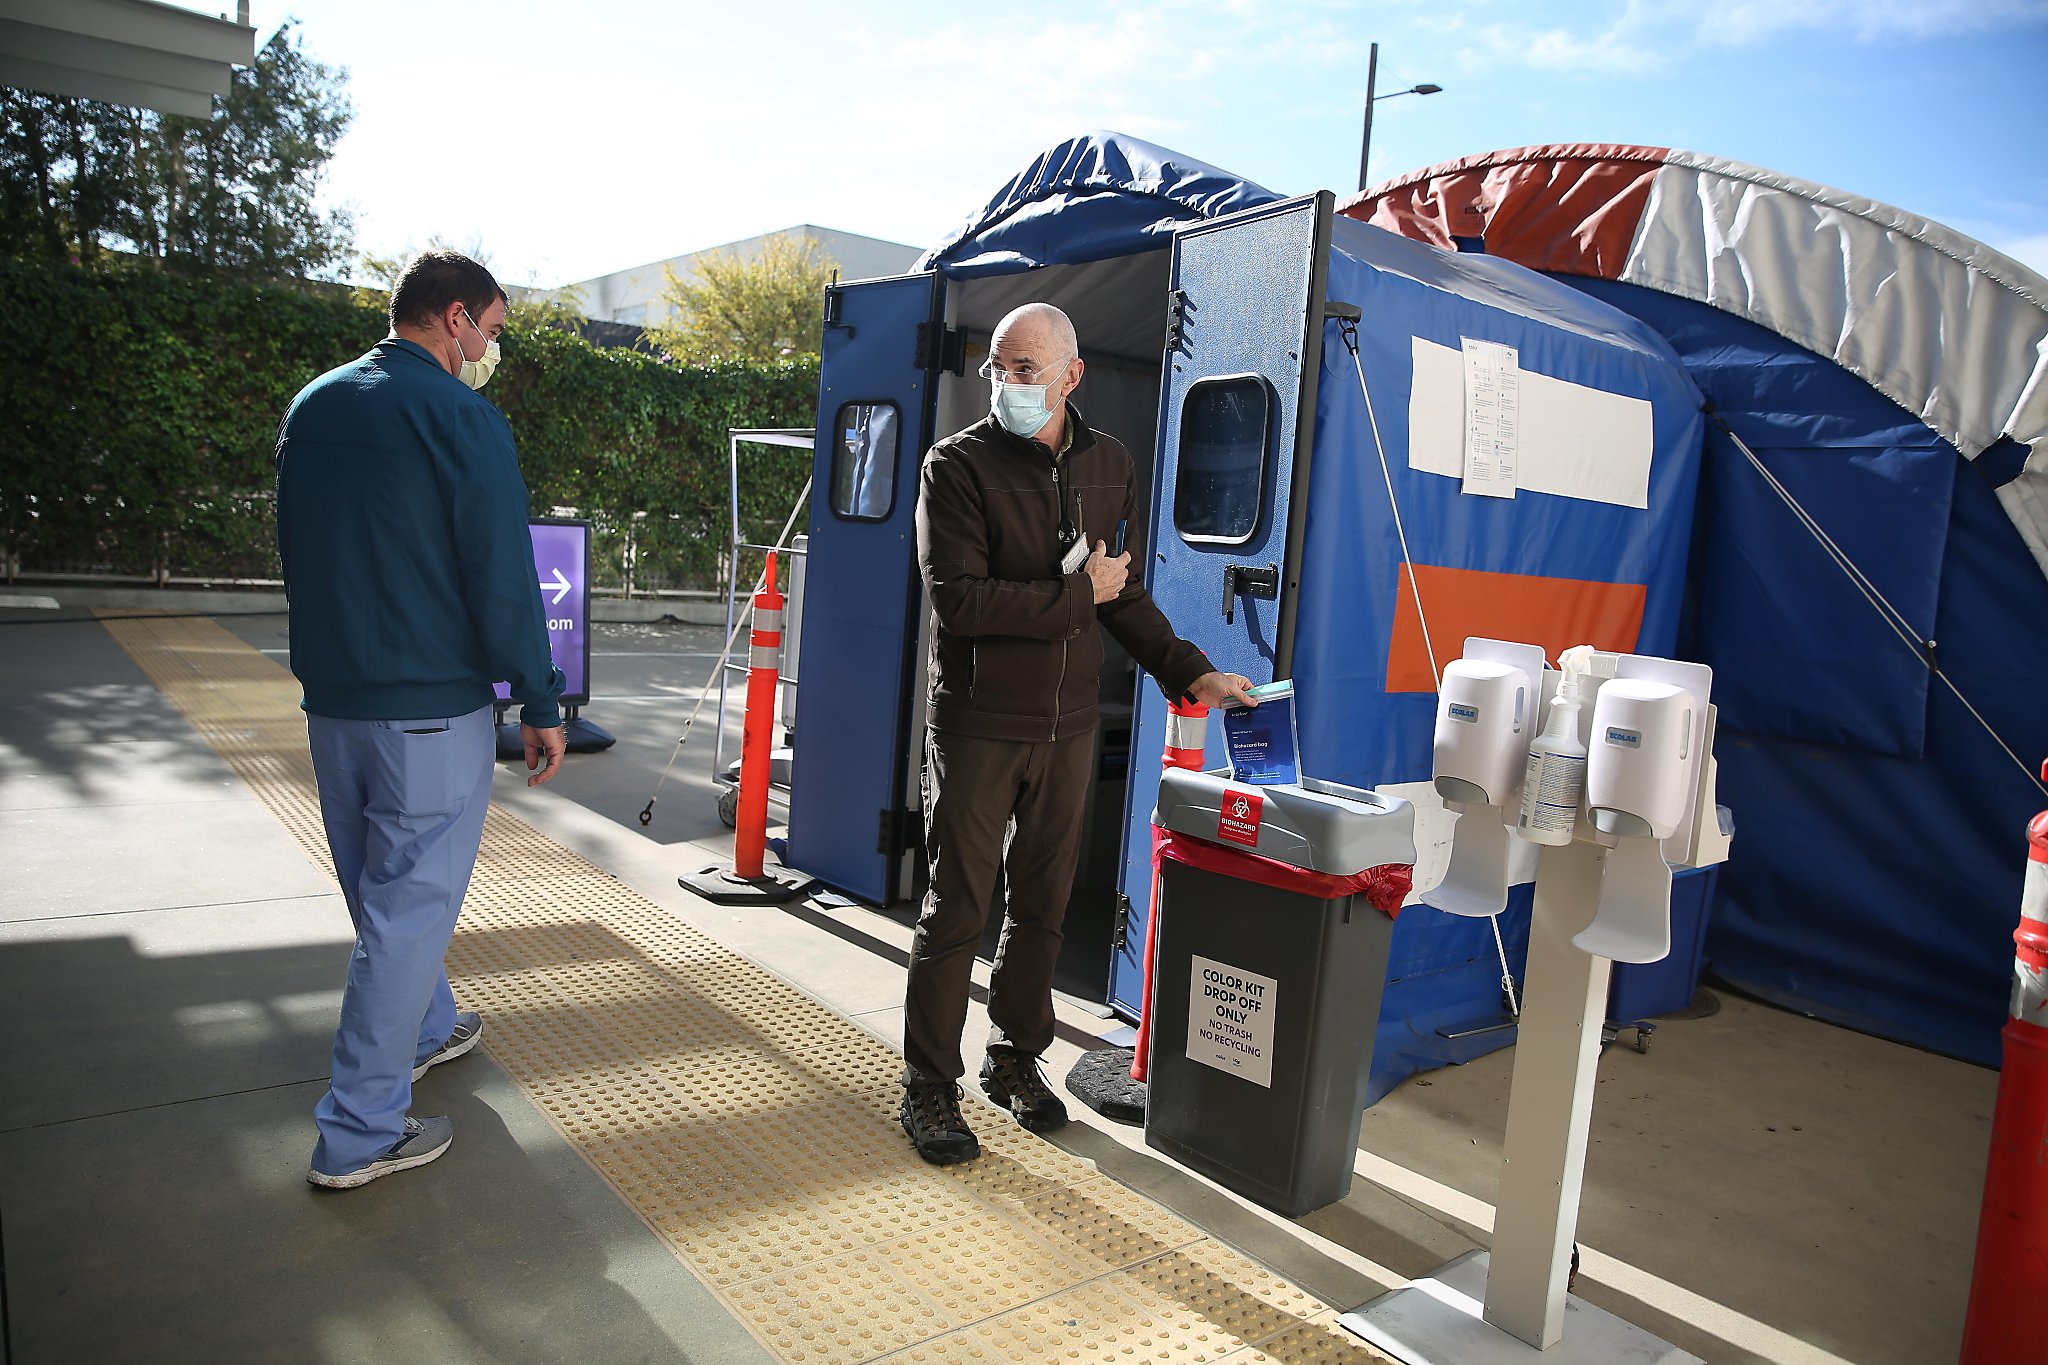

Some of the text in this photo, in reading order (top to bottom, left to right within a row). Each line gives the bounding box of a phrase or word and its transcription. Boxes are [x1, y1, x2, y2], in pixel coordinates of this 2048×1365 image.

[1451, 707, 1475, 718] ECOLAB
[1609, 732, 1637, 743] ECOLAB
[1221, 817, 1256, 832] BIOHAZARD
[1203, 968, 1265, 997] COLOR KIT
[1204, 984, 1262, 1013] DROP OFF
[1215, 1004, 1248, 1025] ONLY
[1208, 1018, 1253, 1042] NO TRASH
[1199, 1028, 1261, 1058] NO RECYCLING
